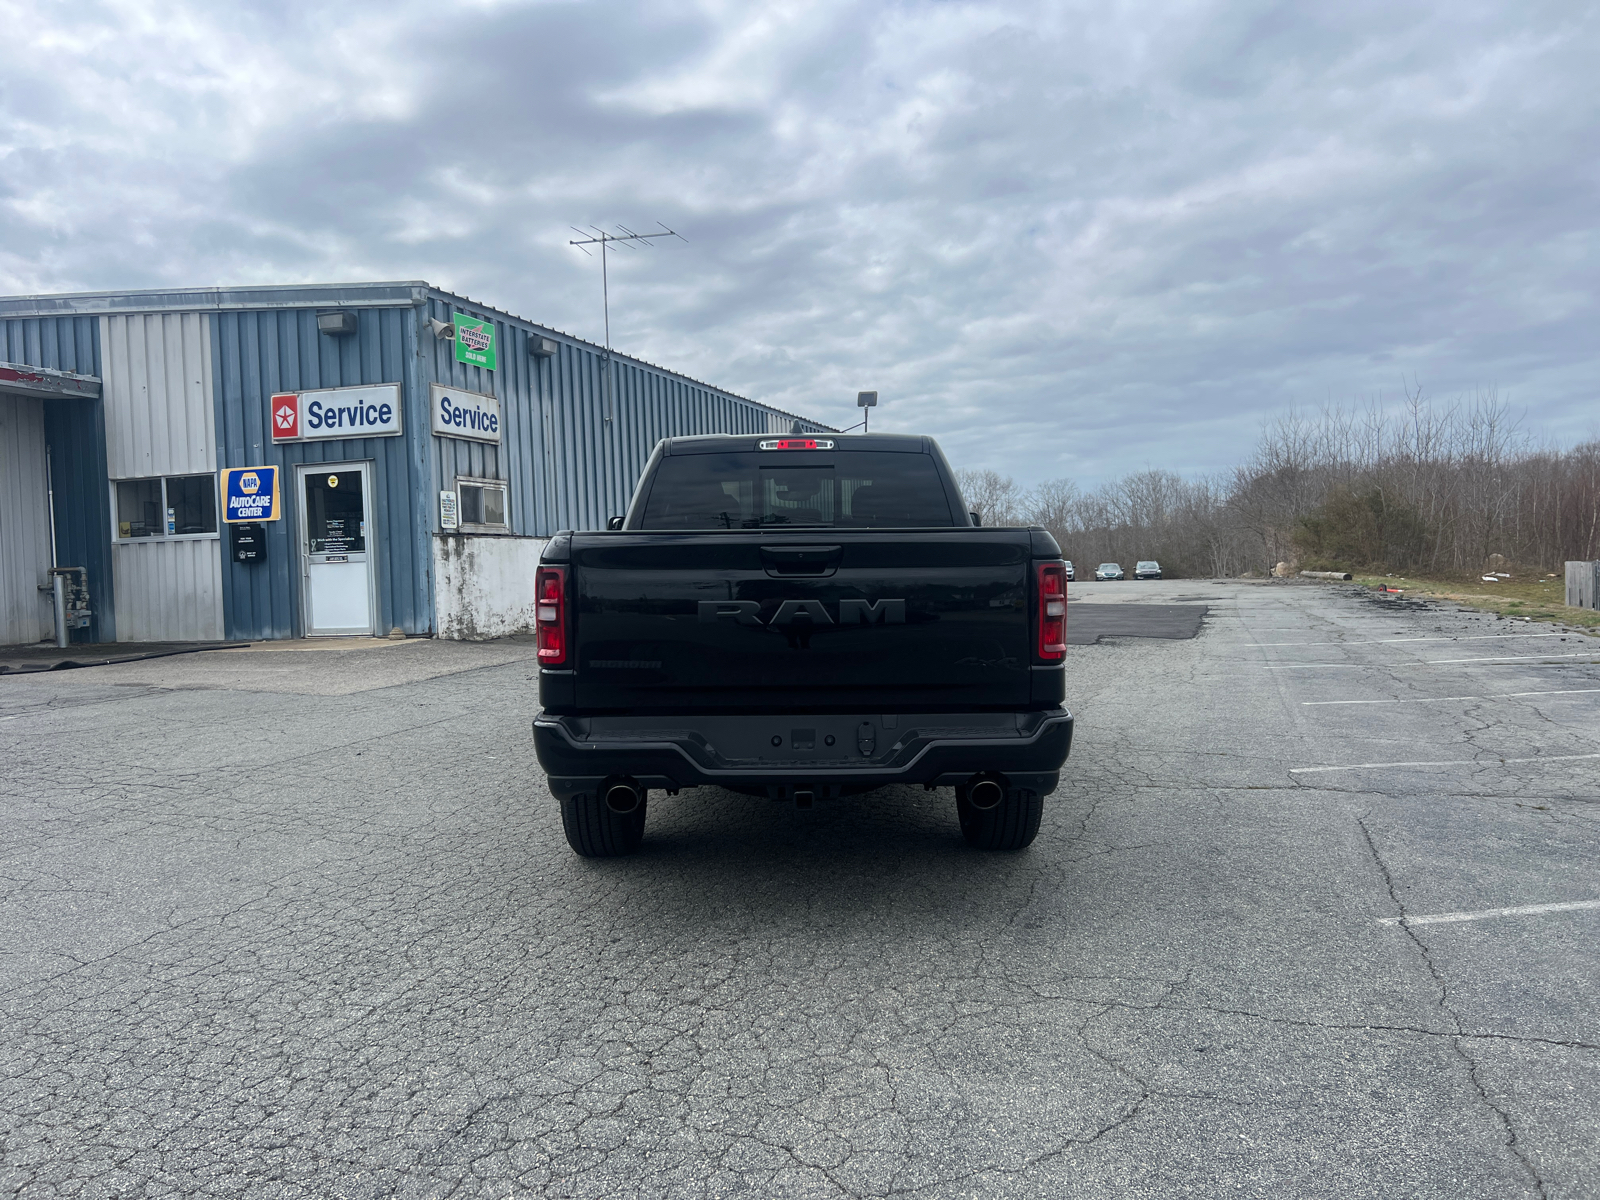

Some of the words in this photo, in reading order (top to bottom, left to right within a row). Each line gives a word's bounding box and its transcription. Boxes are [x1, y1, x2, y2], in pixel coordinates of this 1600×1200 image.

[460, 327, 490, 342] INTERSTATE
[461, 335, 488, 349] BATTERIES
[465, 351, 476, 360] SOLD
[476, 354, 487, 363] HERE
[307, 399, 392, 430] Service
[440, 396, 498, 433] Service
[242, 478, 258, 488] NAPA
[238, 507, 262, 517] CENTER
[697, 598, 906, 625] RAM
